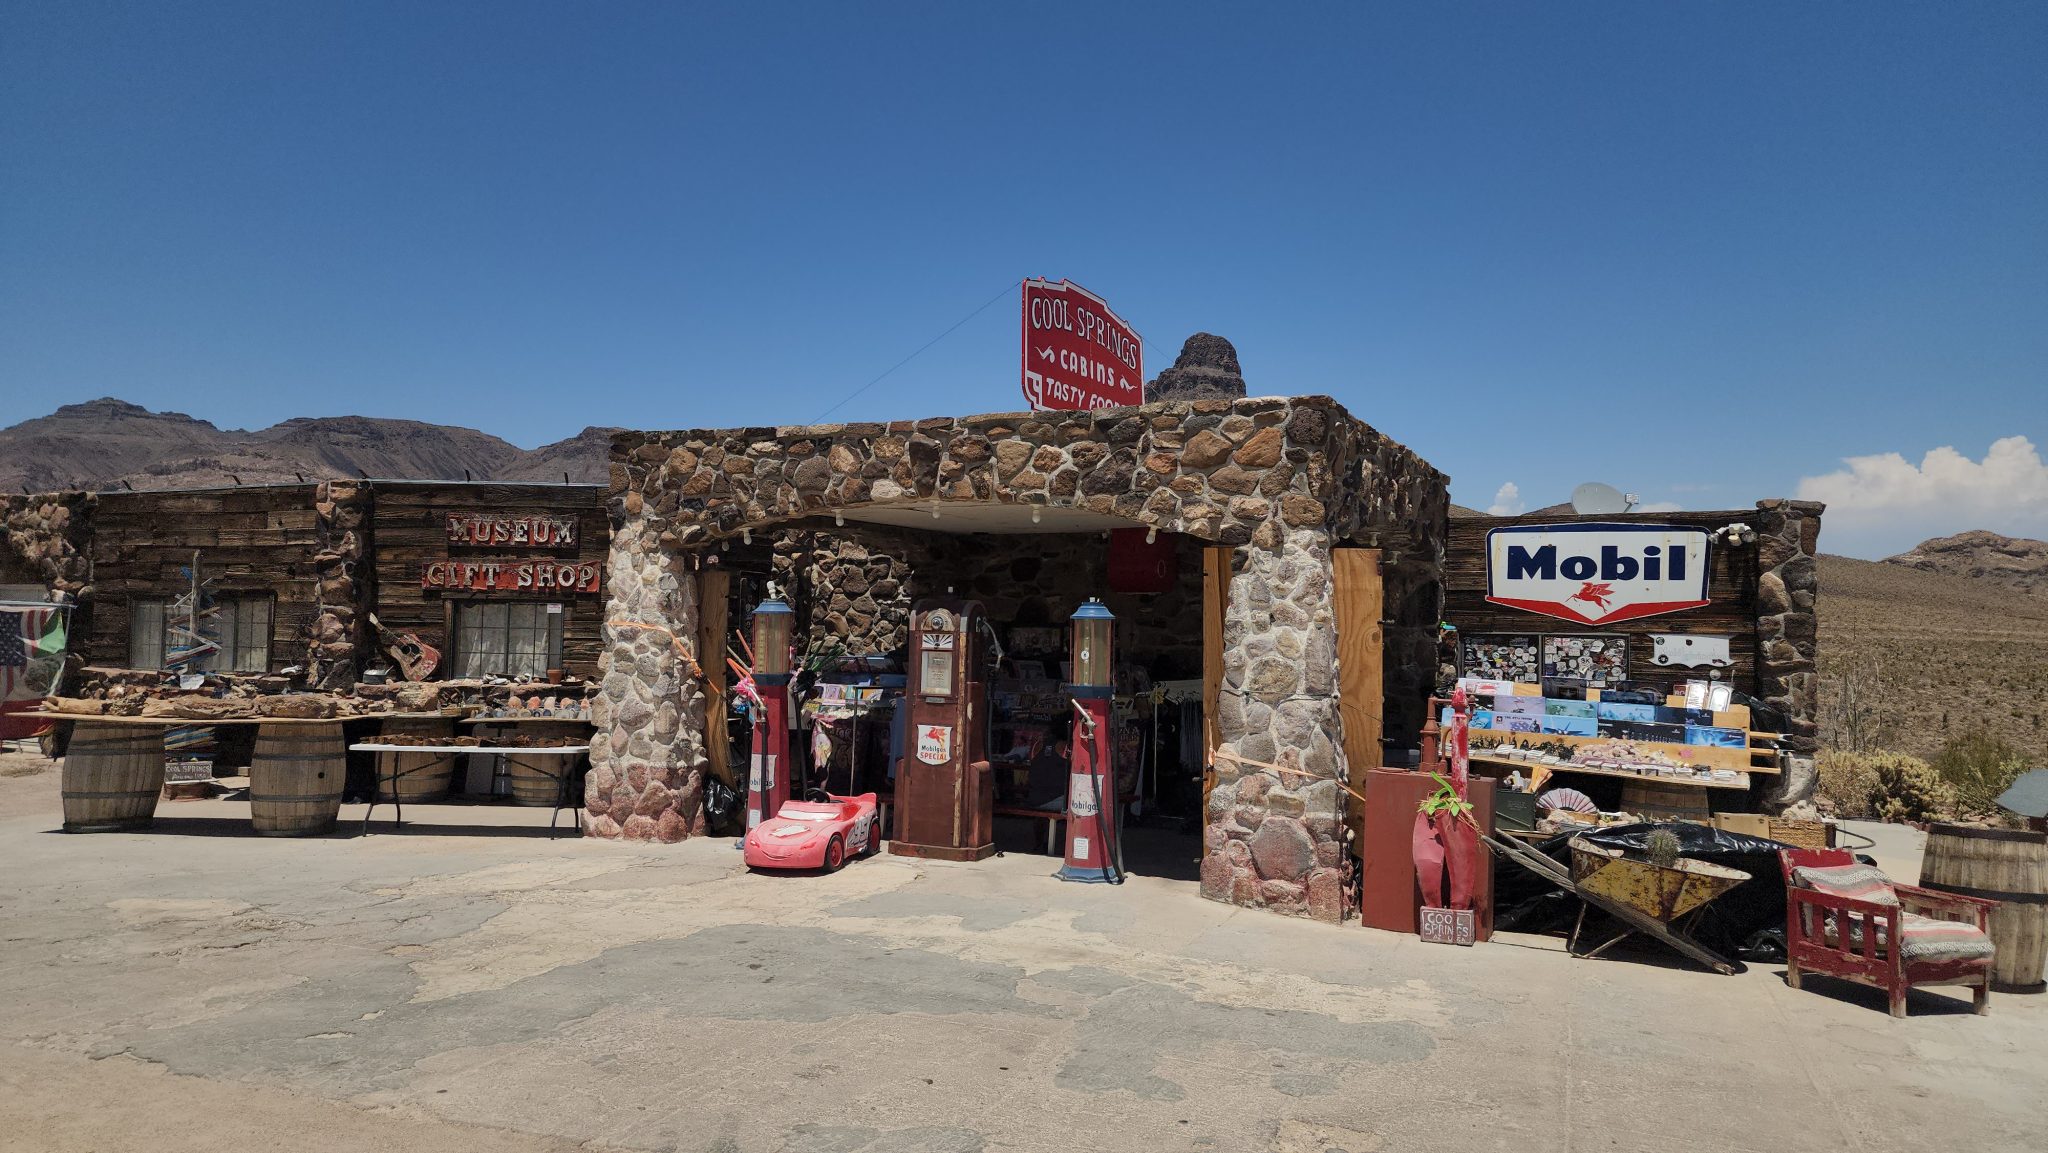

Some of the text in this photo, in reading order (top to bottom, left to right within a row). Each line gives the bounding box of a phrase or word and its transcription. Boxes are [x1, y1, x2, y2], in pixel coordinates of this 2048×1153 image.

[1031, 297, 1136, 370] COOL SPRINGS
[1060, 349, 1115, 387] CABINS
[1046, 377, 1085, 408] TASTY
[450, 518, 573, 543] MUSEUM
[427, 562, 594, 588] GIFT SHOP
[1507, 545, 1686, 580] Mobil
[920, 751, 947, 760] SPECIAL
[921, 745, 946, 753] Mobilgas
[1425, 923, 1468, 937] SPRINGS
[1427, 913, 1463, 925] COOL
